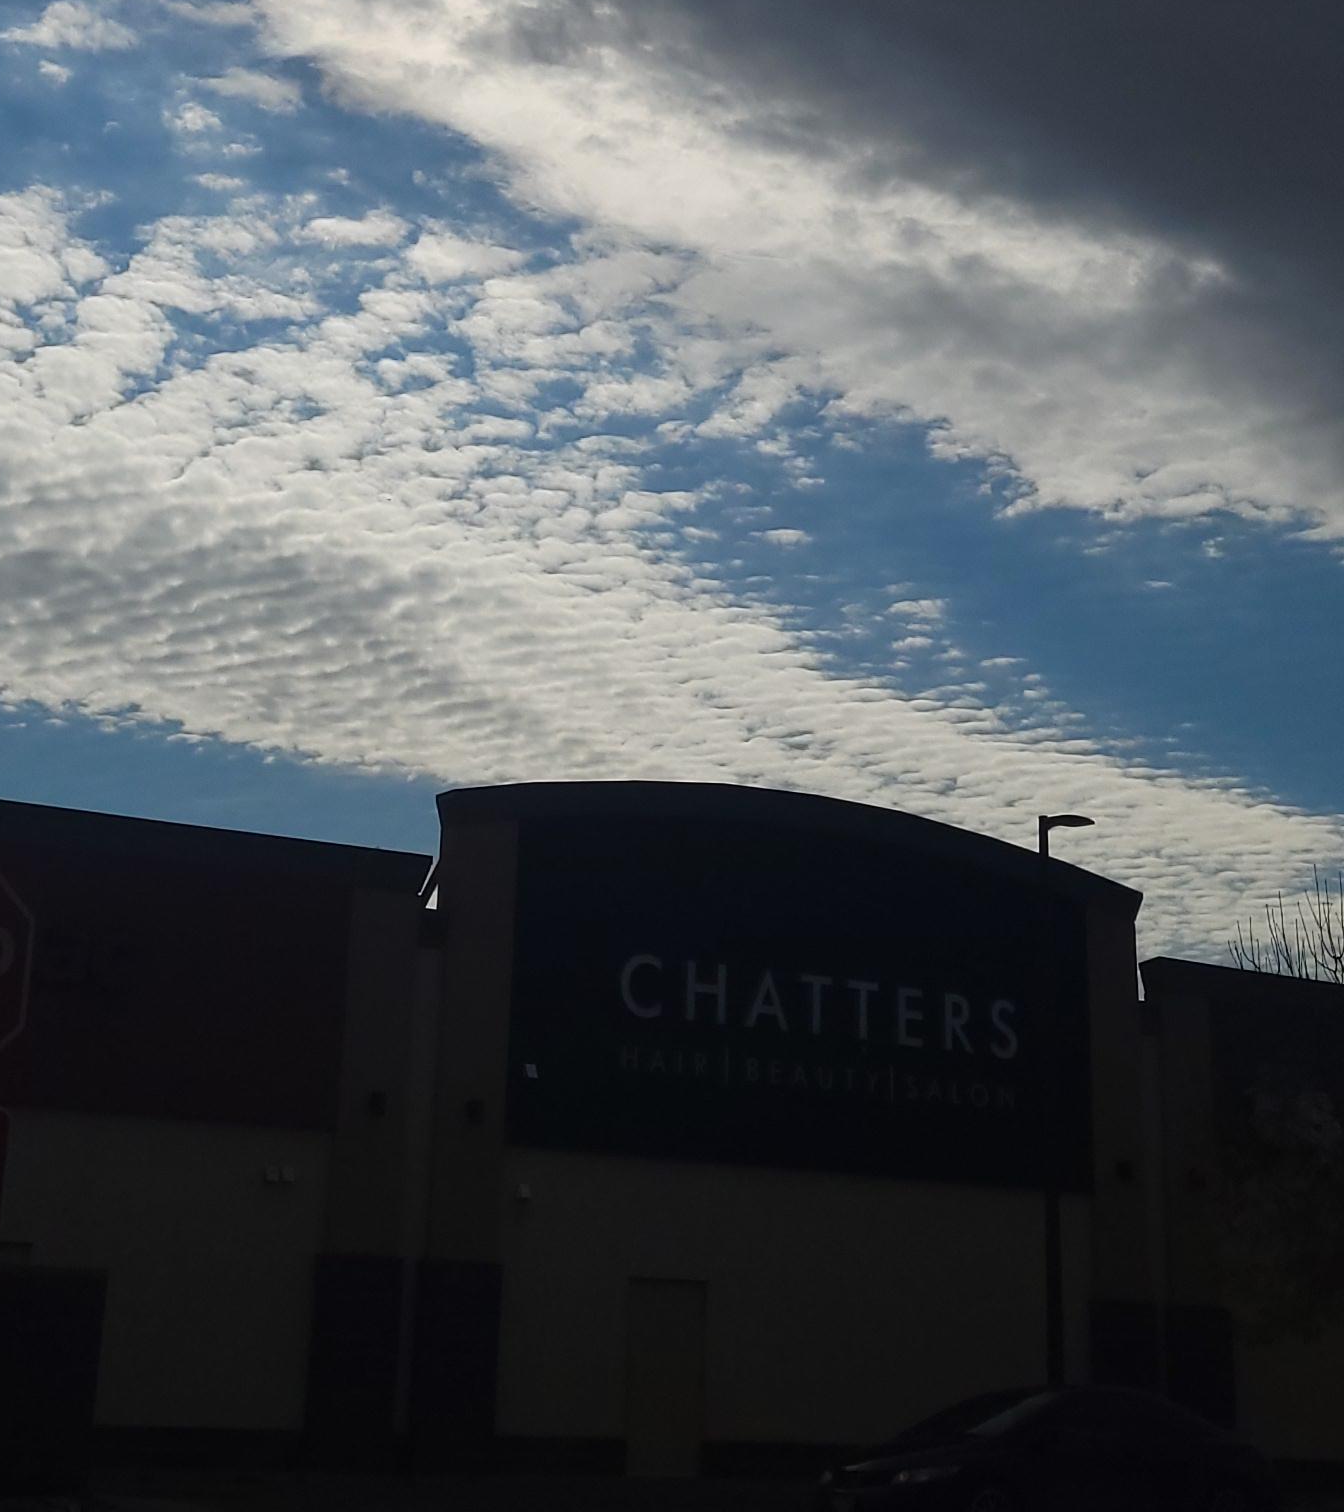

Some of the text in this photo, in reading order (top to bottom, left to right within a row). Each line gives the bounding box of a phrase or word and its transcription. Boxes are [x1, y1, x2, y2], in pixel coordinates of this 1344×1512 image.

[618, 953, 1022, 1061] CHATTERS
[618, 1044, 1019, 1111] HAIR BEAUTY SALON
